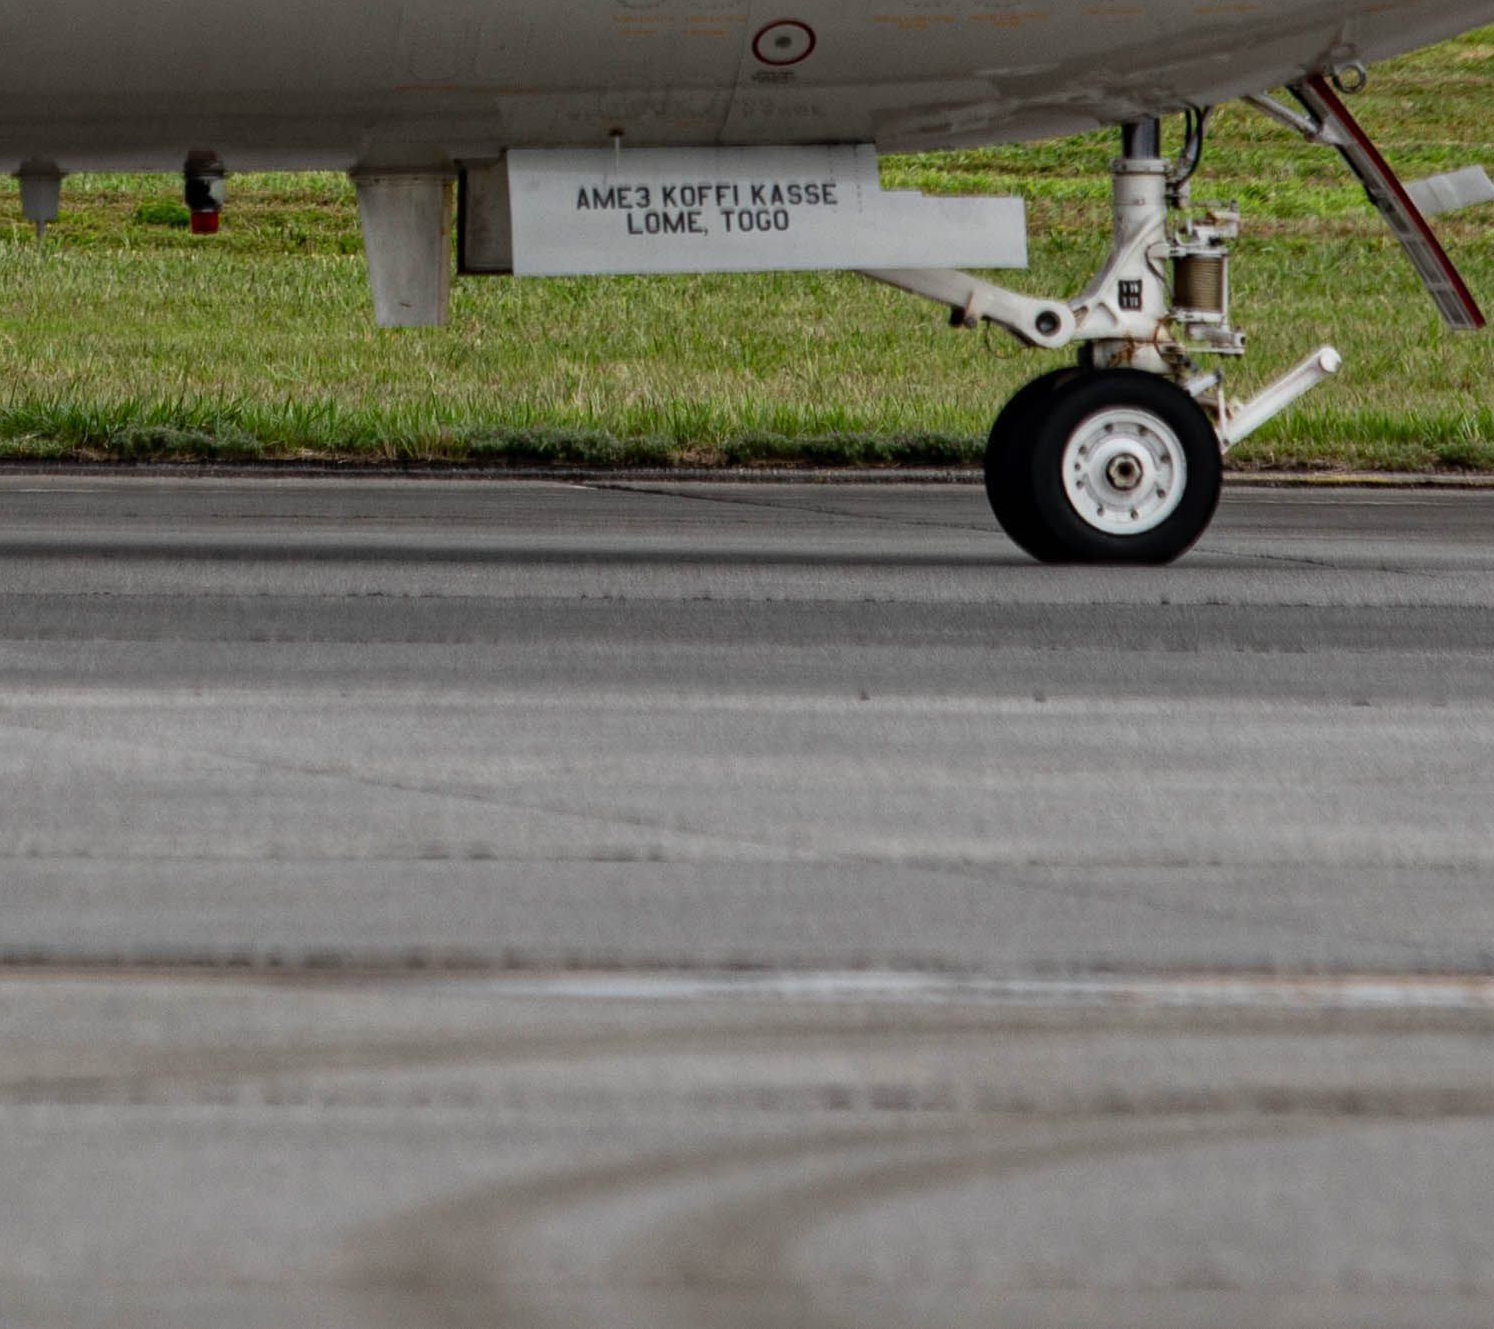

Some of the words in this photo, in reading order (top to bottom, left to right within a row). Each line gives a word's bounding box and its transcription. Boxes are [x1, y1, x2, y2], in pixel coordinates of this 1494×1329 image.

[575, 185, 651, 210] AME3
[661, 184, 740, 208] KOFFI
[750, 183, 839, 206] KASSE
[626, 210, 709, 236] LOME,
[720, 209, 790, 233] TOGO
